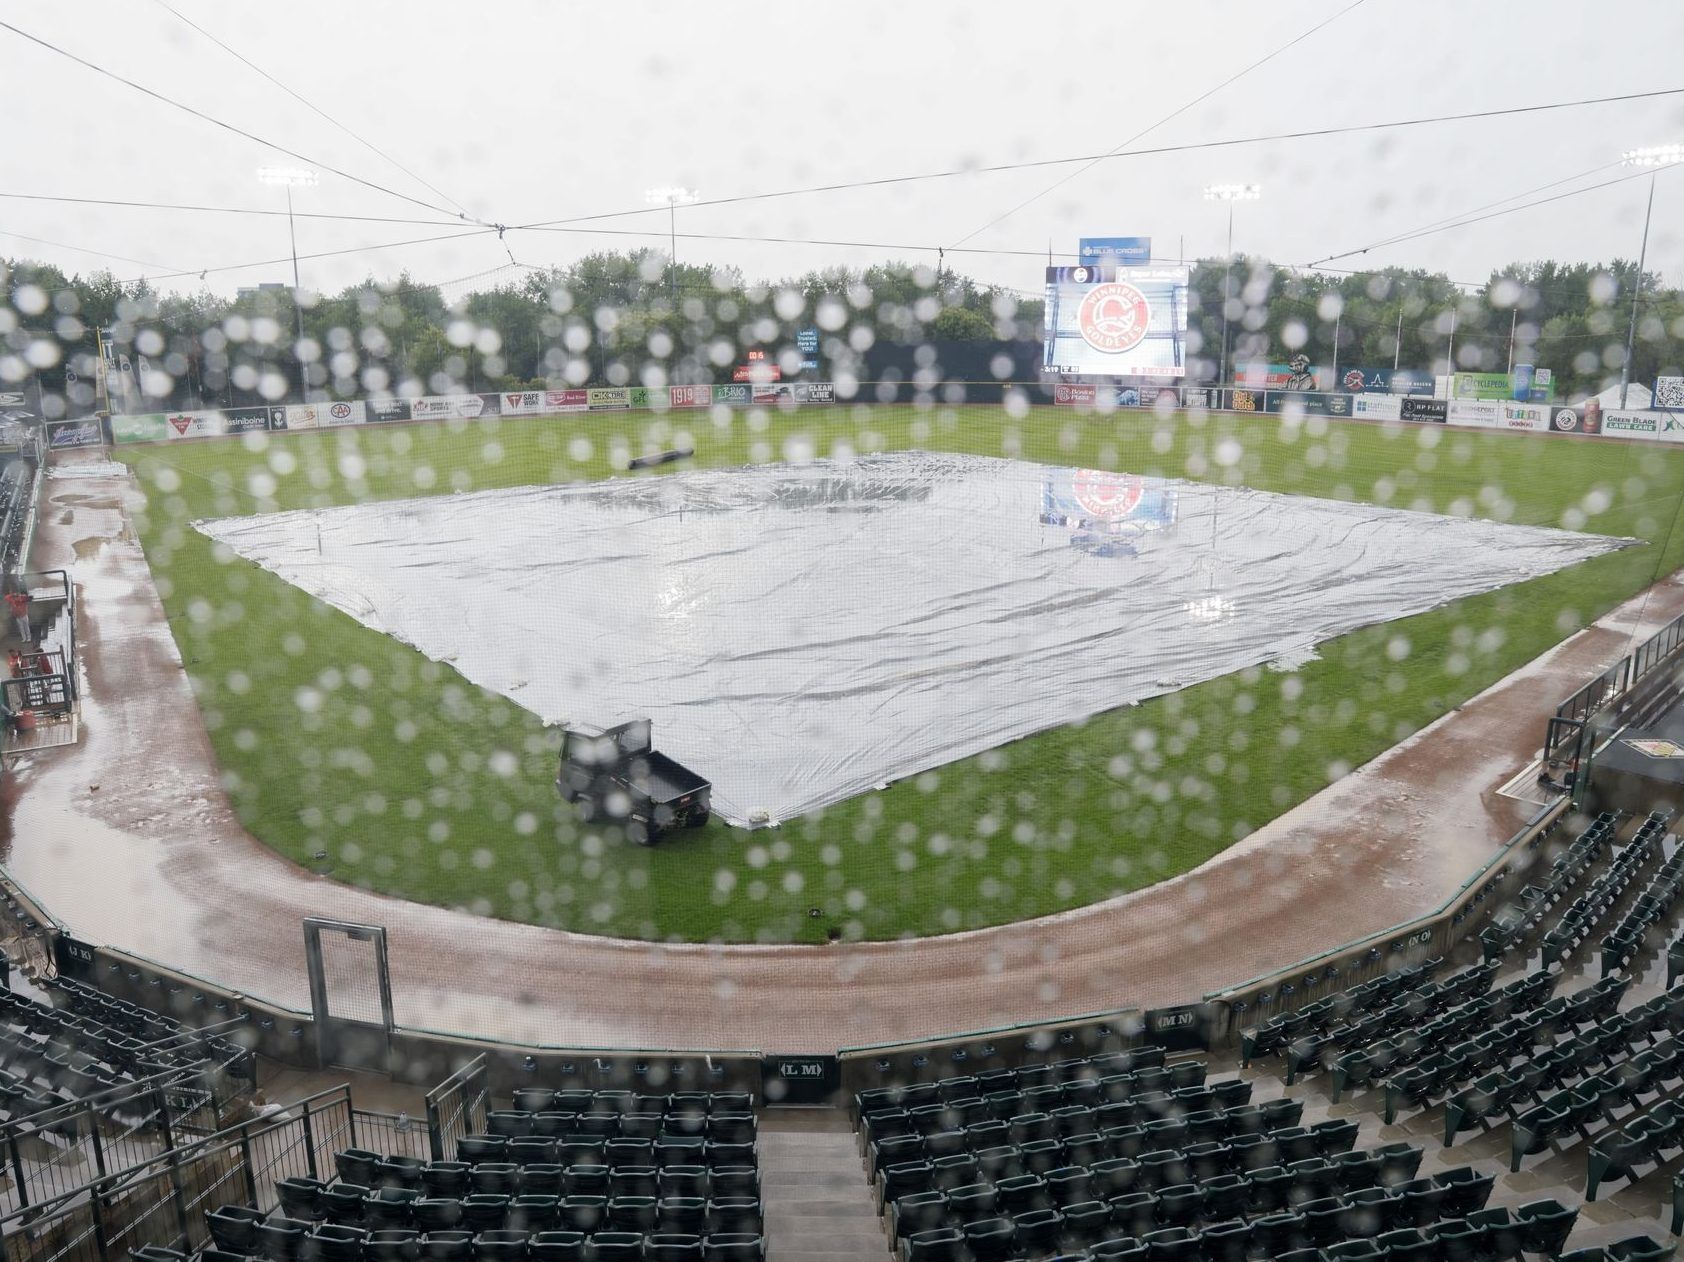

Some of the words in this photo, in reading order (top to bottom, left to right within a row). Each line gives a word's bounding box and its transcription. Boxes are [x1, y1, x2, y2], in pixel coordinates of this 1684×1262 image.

[1088, 284, 1142, 305] WINNIPEG
[1086, 325, 1142, 346] GOLDEYES
[808, 384, 833, 392] CLEAN
[523, 393, 540, 401] SAFE
[672, 388, 693, 404] 1919
[811, 391, 830, 399] LINE
[224, 416, 266, 426] Assiniboine
[1632, 416, 1657, 425] BLADE
[1162, 1015, 1177, 1028] M
[1178, 1013, 1189, 1025] N
[786, 1064, 798, 1075] L
[801, 1064, 817, 1075] M
